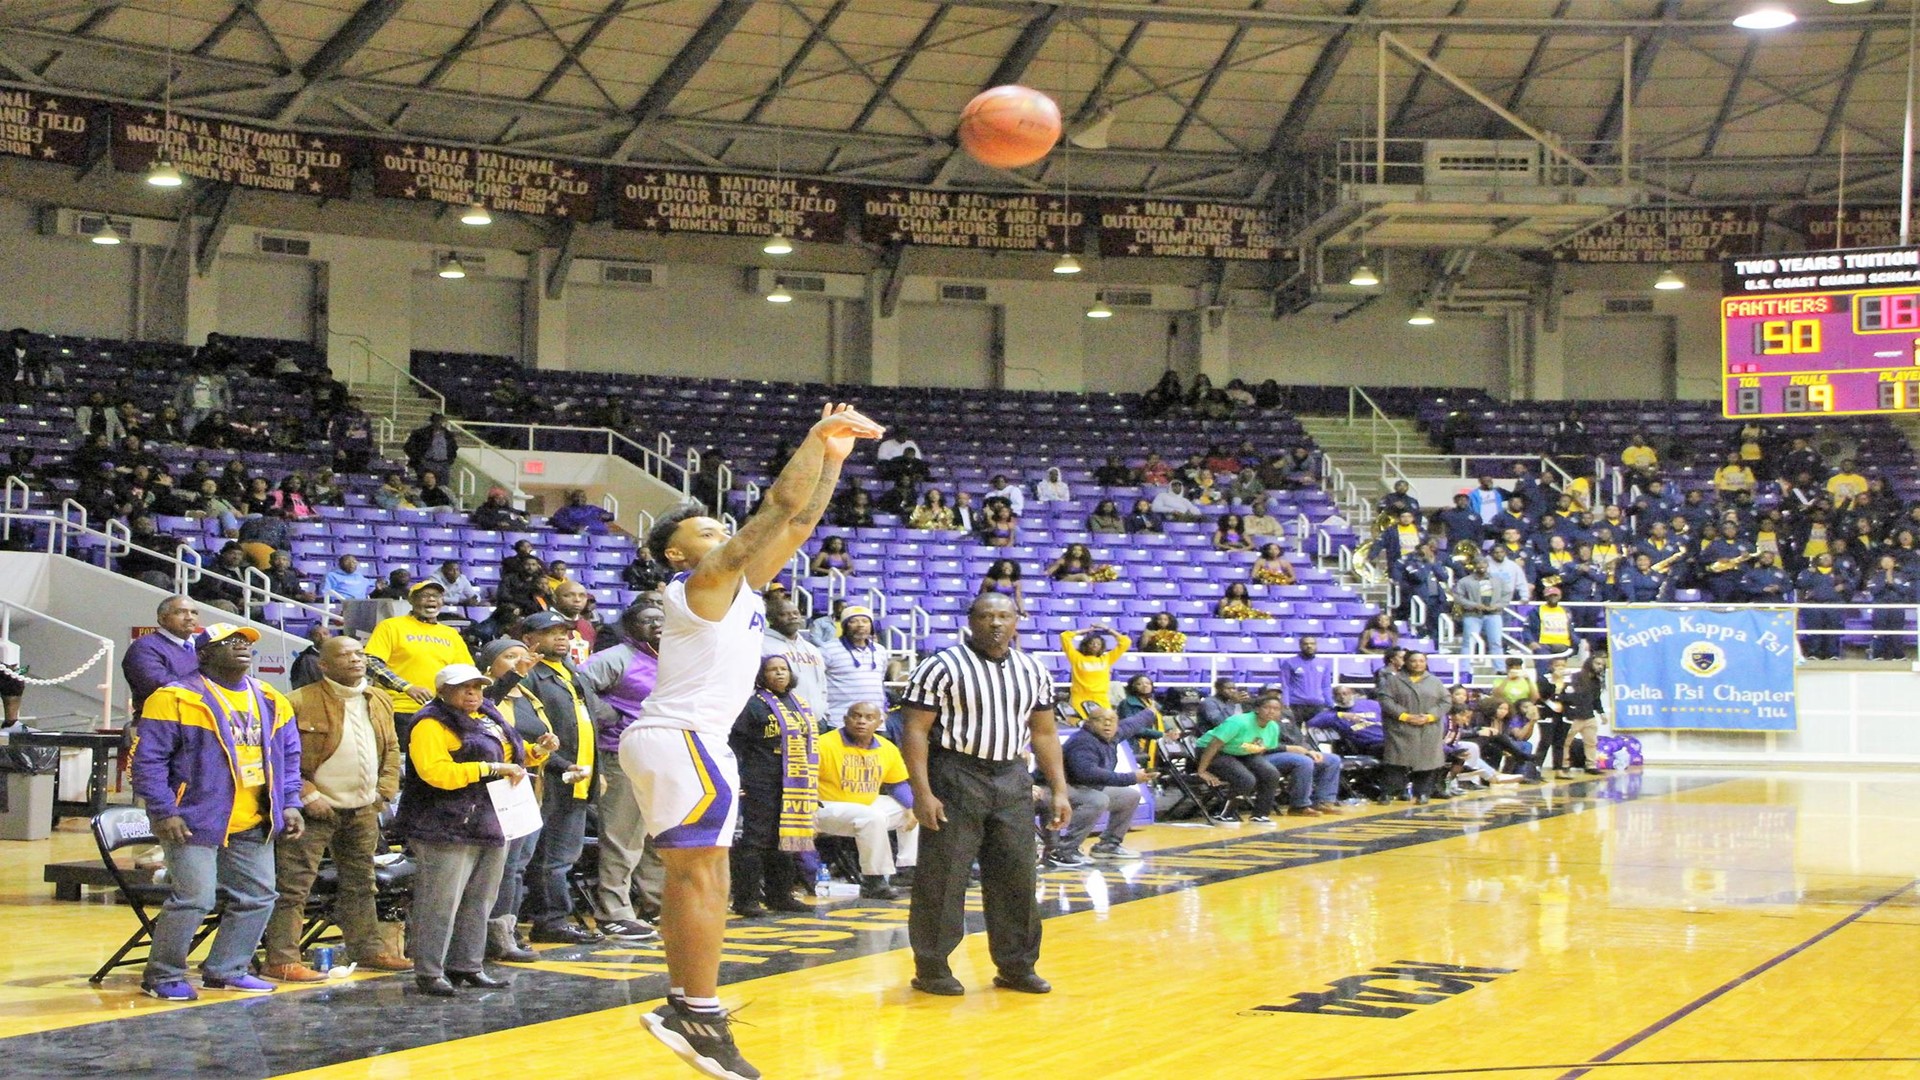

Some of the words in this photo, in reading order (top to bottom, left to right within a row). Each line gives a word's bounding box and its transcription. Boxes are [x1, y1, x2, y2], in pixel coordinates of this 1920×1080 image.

[39, 112, 86, 133] FIELD
[0, 122, 43, 144] 1983
[220, 124, 301, 149] NATIONAL
[126, 125, 188, 148] INDOOR
[196, 136, 250, 161] TRACK
[257, 147, 290, 163] AND
[296, 150, 341, 168] FIELD
[424, 146, 469, 165] NAIA
[476, 151, 557, 176] NATIONAL
[240, 172, 294, 190] DIVISION
[269, 163, 310, 180] 1984
[384, 155, 466, 179] OUTDOOR
[475, 167, 529, 186] TRACK
[549, 176, 589, 195] FIELD
[416, 174, 512, 198] CHAMPIONS
[665, 172, 708, 190] NAIA
[720, 176, 798, 196] NATIONAL
[430, 188, 486, 205] WOMEN
[493, 197, 546, 214] DIVISION
[625, 184, 710, 204] OUTDOOR
[719, 190, 775, 208] TRACK
[791, 196, 837, 213] FIELD
[909, 191, 949, 206] NAIA
[958, 194, 1040, 210] NATIONAL
[657, 202, 758, 222] CHAMPIONS
[865, 201, 941, 220] OUTDOOR
[948, 207, 998, 222] TRACK
[1004, 210, 1037, 224] AND
[1040, 211, 1083, 226] FIELD
[1145, 202, 1185, 216] NAIA
[669, 218, 728, 232] WOMENS
[736, 221, 796, 236] DIVISON
[899, 218, 998, 236] CHAMPIONS
[1102, 214, 1175, 230] OUTDOOR
[1182, 218, 1233, 233] TRACK
[1711, 221, 1759, 235] FIELD
[913, 233, 969, 246] WOMENS
[977, 237, 1037, 249] DIVISION
[1135, 230, 1232, 246] CHAMPIONS
[1735, 260, 1777, 275] TWO
[1779, 256, 1841, 273] YEARS
[1844, 251, 1918, 269] TUITION
[1745, 279, 1771, 290] U.S.
[1773, 277, 1818, 289] COAST
[1819, 274, 1867, 286] GUARD
[1727, 298, 1829, 317] PANTHERS
[1763, 319, 1821, 355] 50
[1790, 375, 1829, 386] FOULS
[406, 634, 451, 647] PVAMU
[1611, 624, 1673, 651] Kappa
[1679, 615, 1747, 642] Kappa
[1755, 630, 1789, 656] Psi
[1614, 683, 1664, 701] Delta
[1674, 683, 1704, 700] Psi
[1713, 684, 1795, 706] Chapter
[841, 780, 880, 793] PVAMU
[1249, 959, 1520, 1019] NCAA
